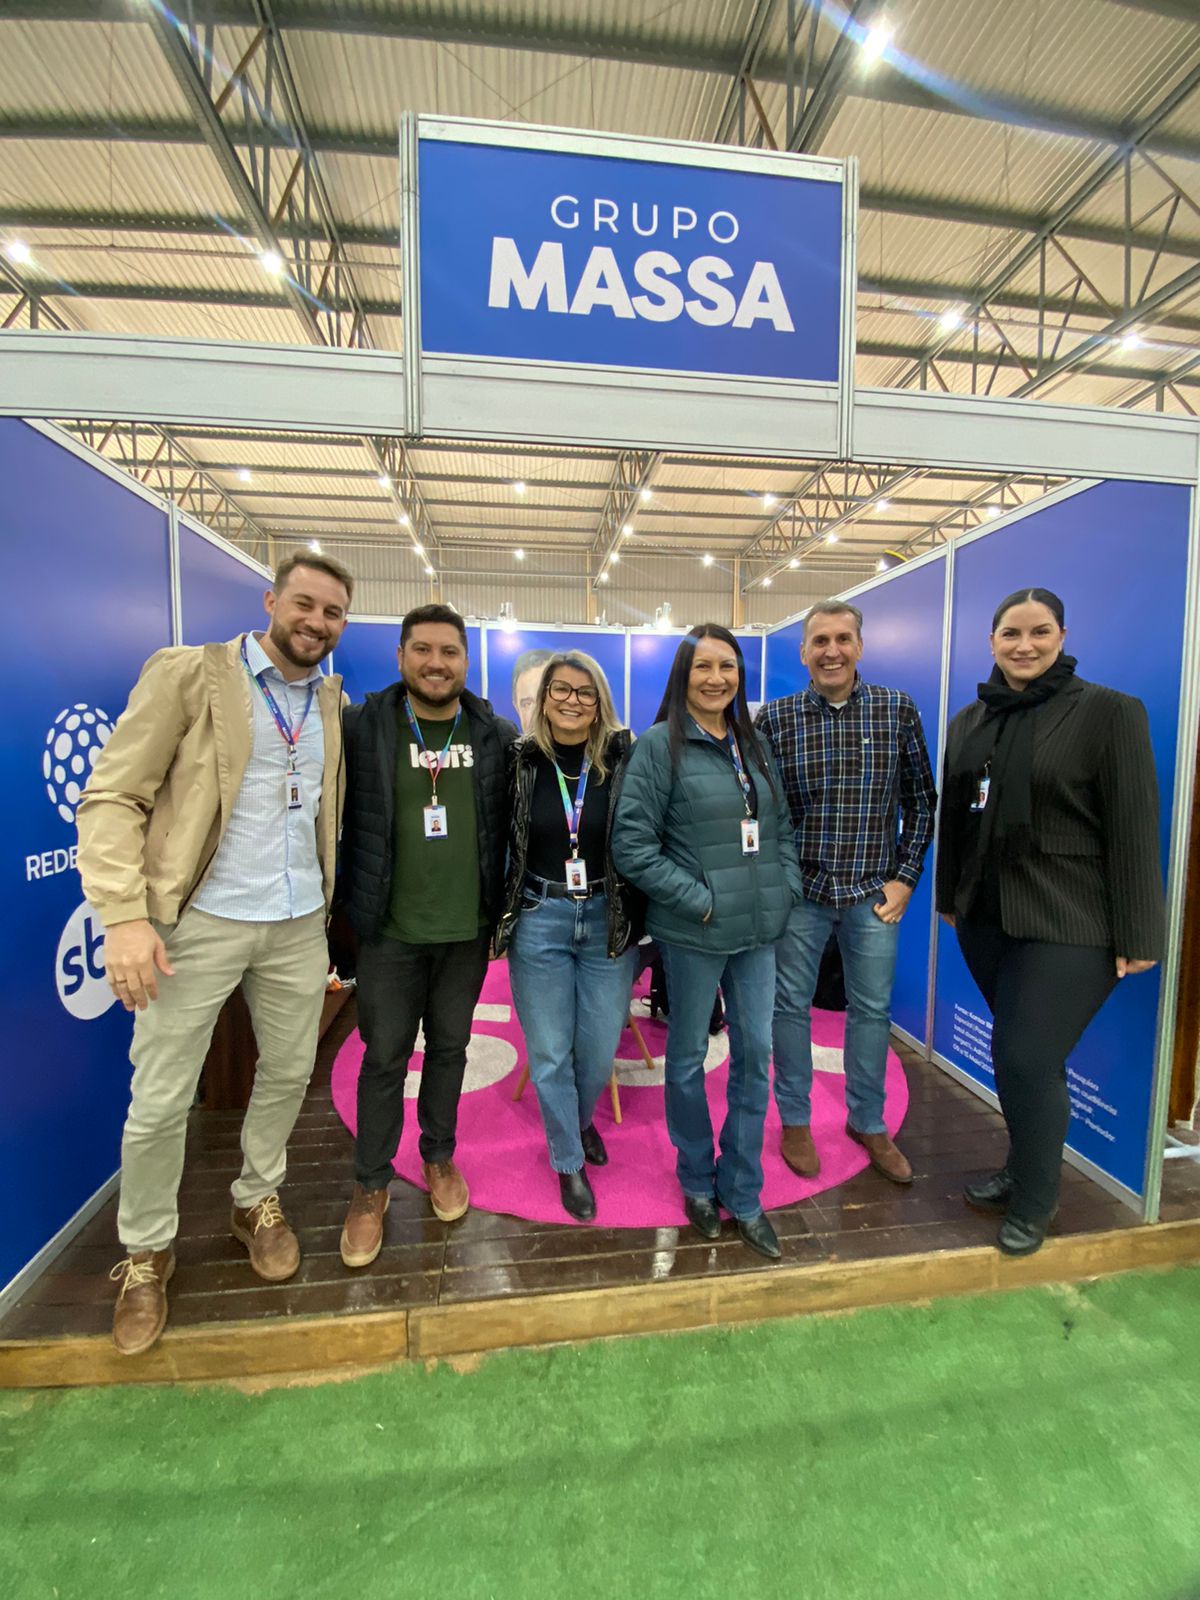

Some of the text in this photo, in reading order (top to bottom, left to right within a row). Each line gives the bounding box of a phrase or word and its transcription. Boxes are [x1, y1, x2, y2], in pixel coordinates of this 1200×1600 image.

[550, 195, 740, 244] GRUPO
[488, 237, 795, 333] MASSA
[25, 845, 78, 882] REDE
